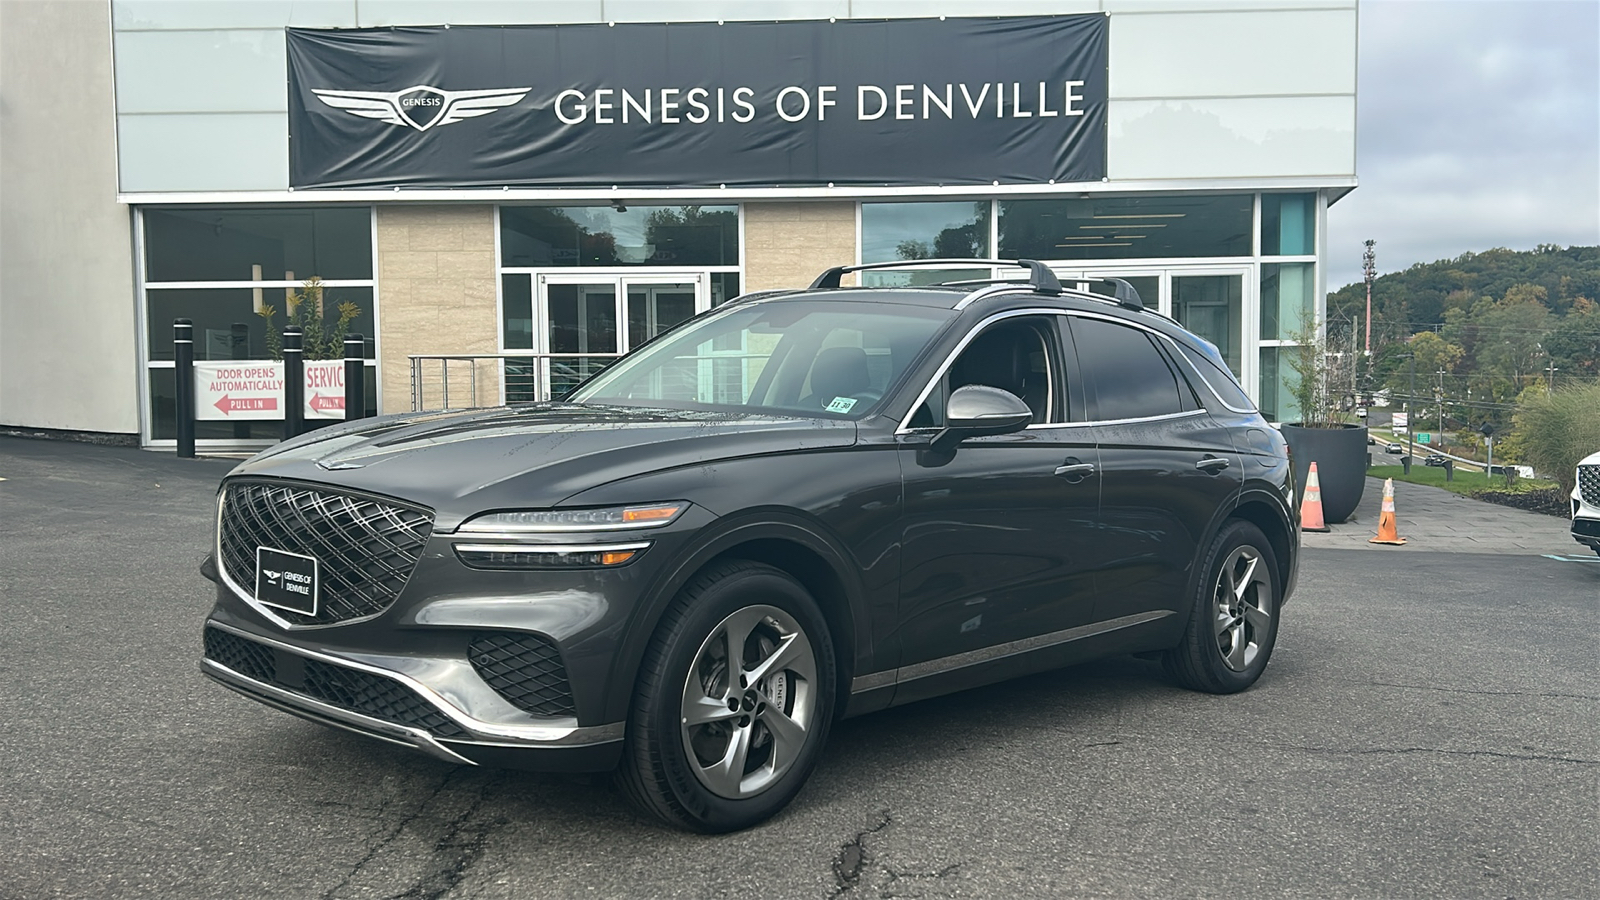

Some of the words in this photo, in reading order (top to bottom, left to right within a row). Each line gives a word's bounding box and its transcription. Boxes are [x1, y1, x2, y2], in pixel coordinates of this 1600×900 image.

[403, 98, 440, 106] GENESIS
[554, 87, 756, 124] GENESIS
[775, 85, 837, 122] OF
[857, 80, 1084, 120] DENVILLE
[217, 369, 242, 379] DOOR
[245, 367, 275, 378] OPENS
[307, 366, 345, 388] SERVIC
[210, 380, 283, 391] AUTOMATICALLY
[231, 400, 251, 409] PULL
[254, 399, 264, 408] IN
[284, 571, 303, 582] GENESIS
[303, 575, 311, 584] OF
[286, 583, 309, 595] DENVILLE
